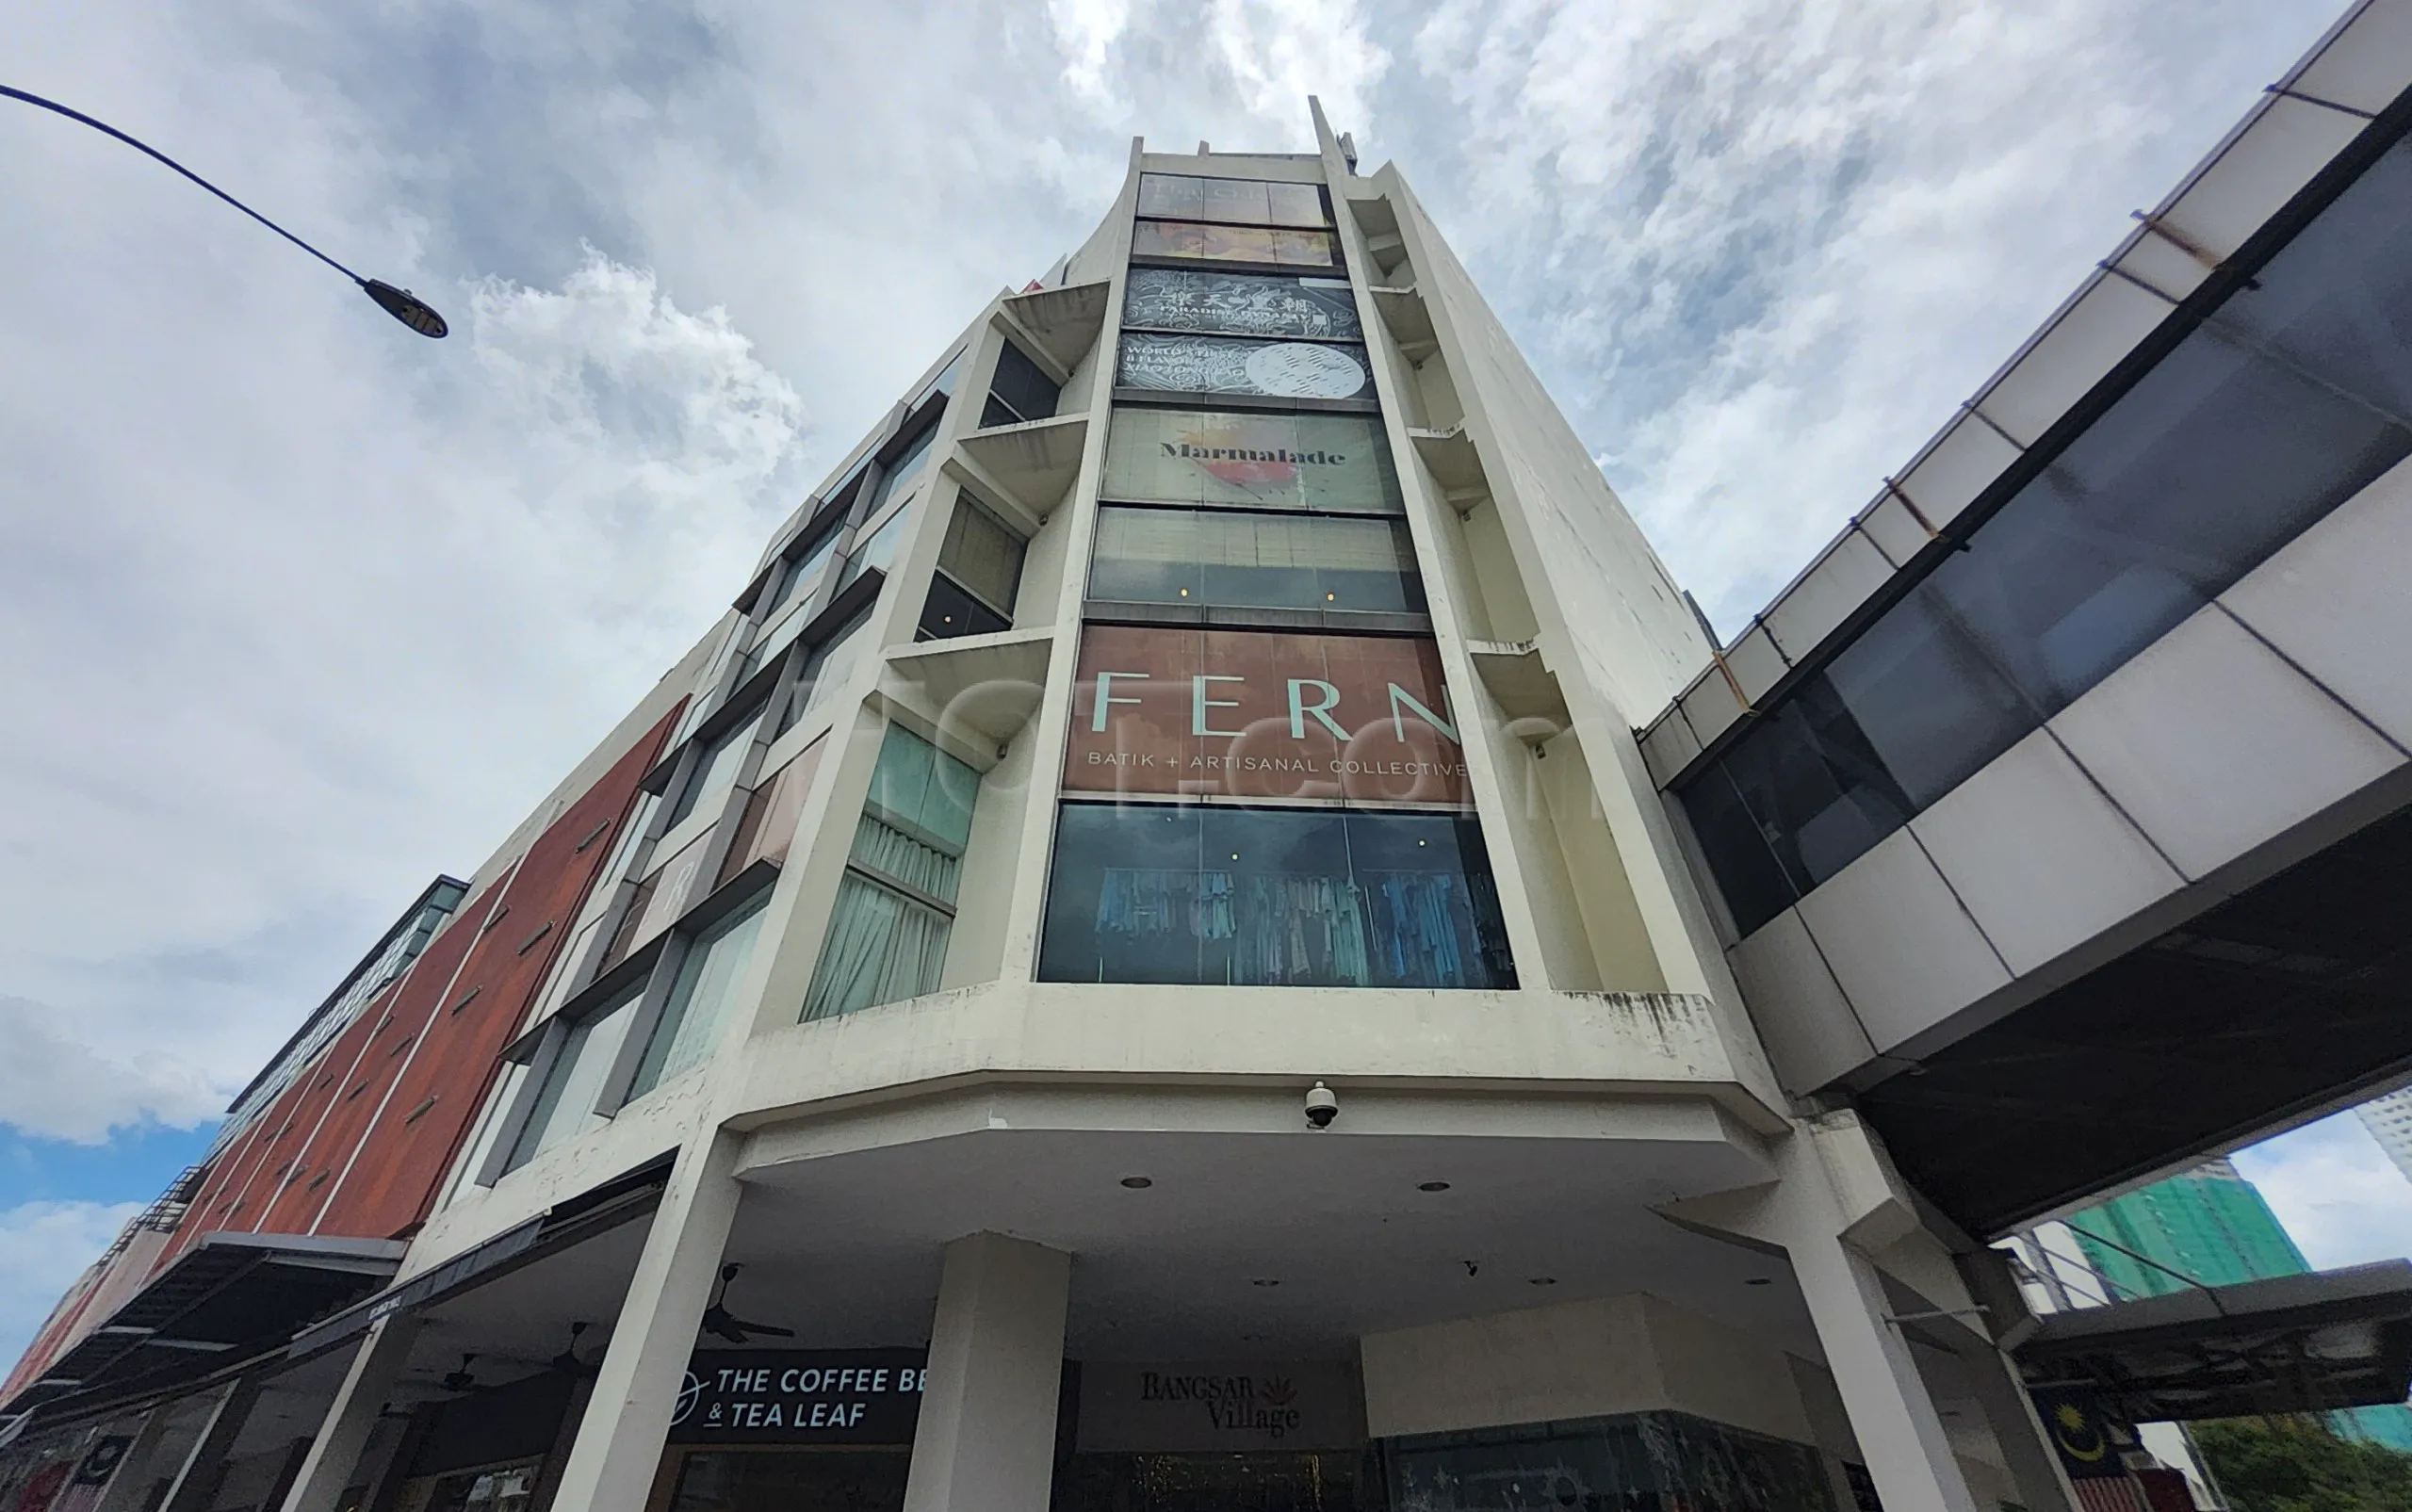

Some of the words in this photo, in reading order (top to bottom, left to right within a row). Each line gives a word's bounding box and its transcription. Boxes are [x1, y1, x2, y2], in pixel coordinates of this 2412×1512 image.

[1160, 442, 1346, 466] Marmalade
[1092, 672, 1460, 744] FERN
[1088, 752, 1154, 768] BATIK
[1190, 756, 1318, 772] ARTISANAL
[1329, 759, 1467, 777] COLLECTIVE
[717, 1368, 771, 1393] THE
[780, 1368, 888, 1392] COFFEE
[1139, 1371, 1257, 1402] BANGSAR
[708, 1402, 723, 1422] &
[731, 1403, 784, 1427] TEA
[793, 1403, 866, 1427] LEAF
[1205, 1398, 1301, 1439] Village
